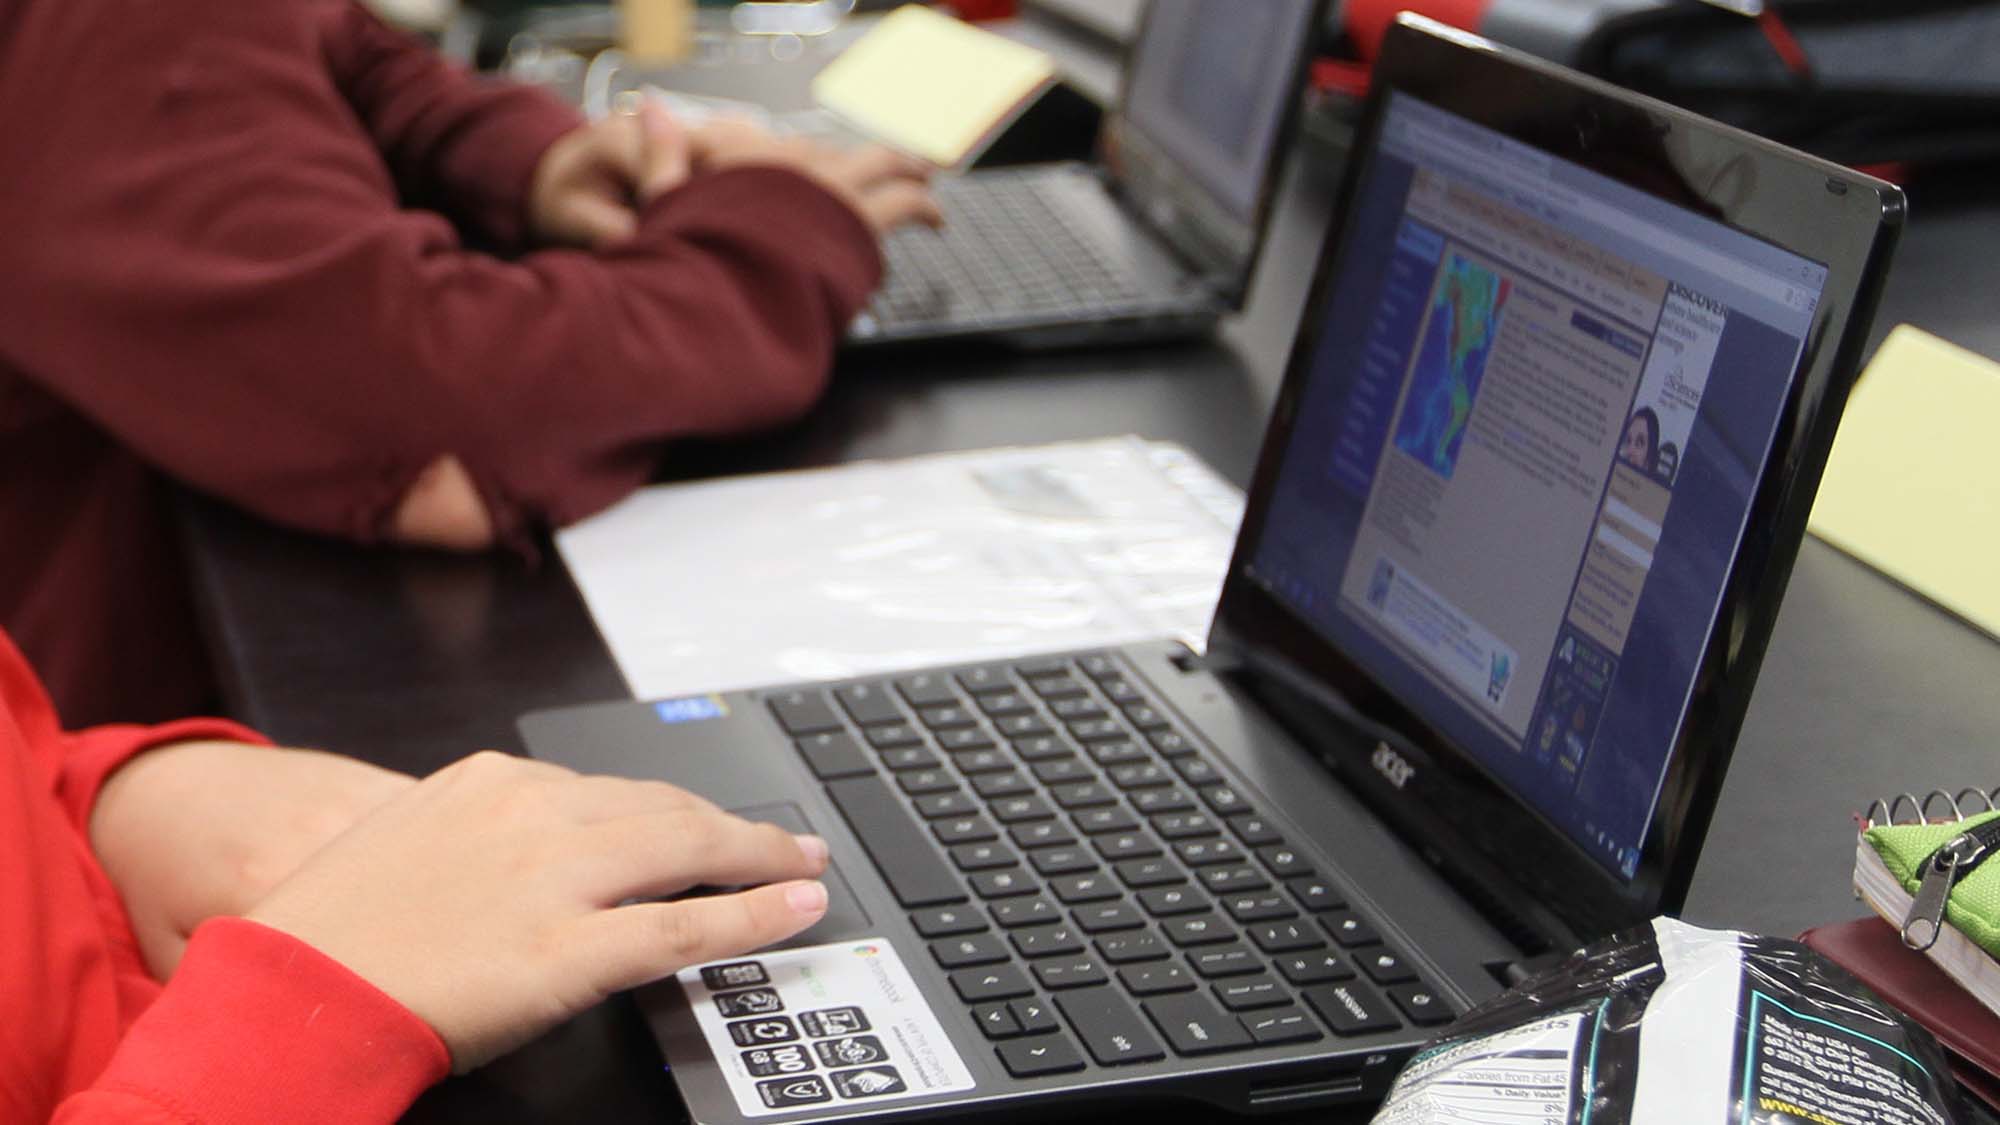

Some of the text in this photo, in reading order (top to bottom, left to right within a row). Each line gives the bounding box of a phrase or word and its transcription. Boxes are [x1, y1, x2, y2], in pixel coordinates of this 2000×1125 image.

[1371, 741, 1416, 788] acer
[1765, 1014, 1793, 1034] Made
[1793, 1027, 1805, 1038] in
[1806, 1031, 1825, 1043] the
[1825, 1036, 1850, 1052] USA
[751, 1051, 770, 1065] GB
[772, 1046, 806, 1072] 100
[1801, 1039, 1824, 1055] Pita
[1825, 1047, 1850, 1062] Chip
[1457, 1071, 1567, 1084] Calories from Fat 45
[1776, 1049, 1802, 1066] 2012
[1841, 1073, 1865, 1088] Pita
[1865, 1080, 1890, 1096] Chip
[1504, 1088, 1530, 1099] Daily
[1760, 1076, 1781, 1088] call
[1782, 1081, 1801, 1095] the
[1802, 1087, 1826, 1106] Chip
